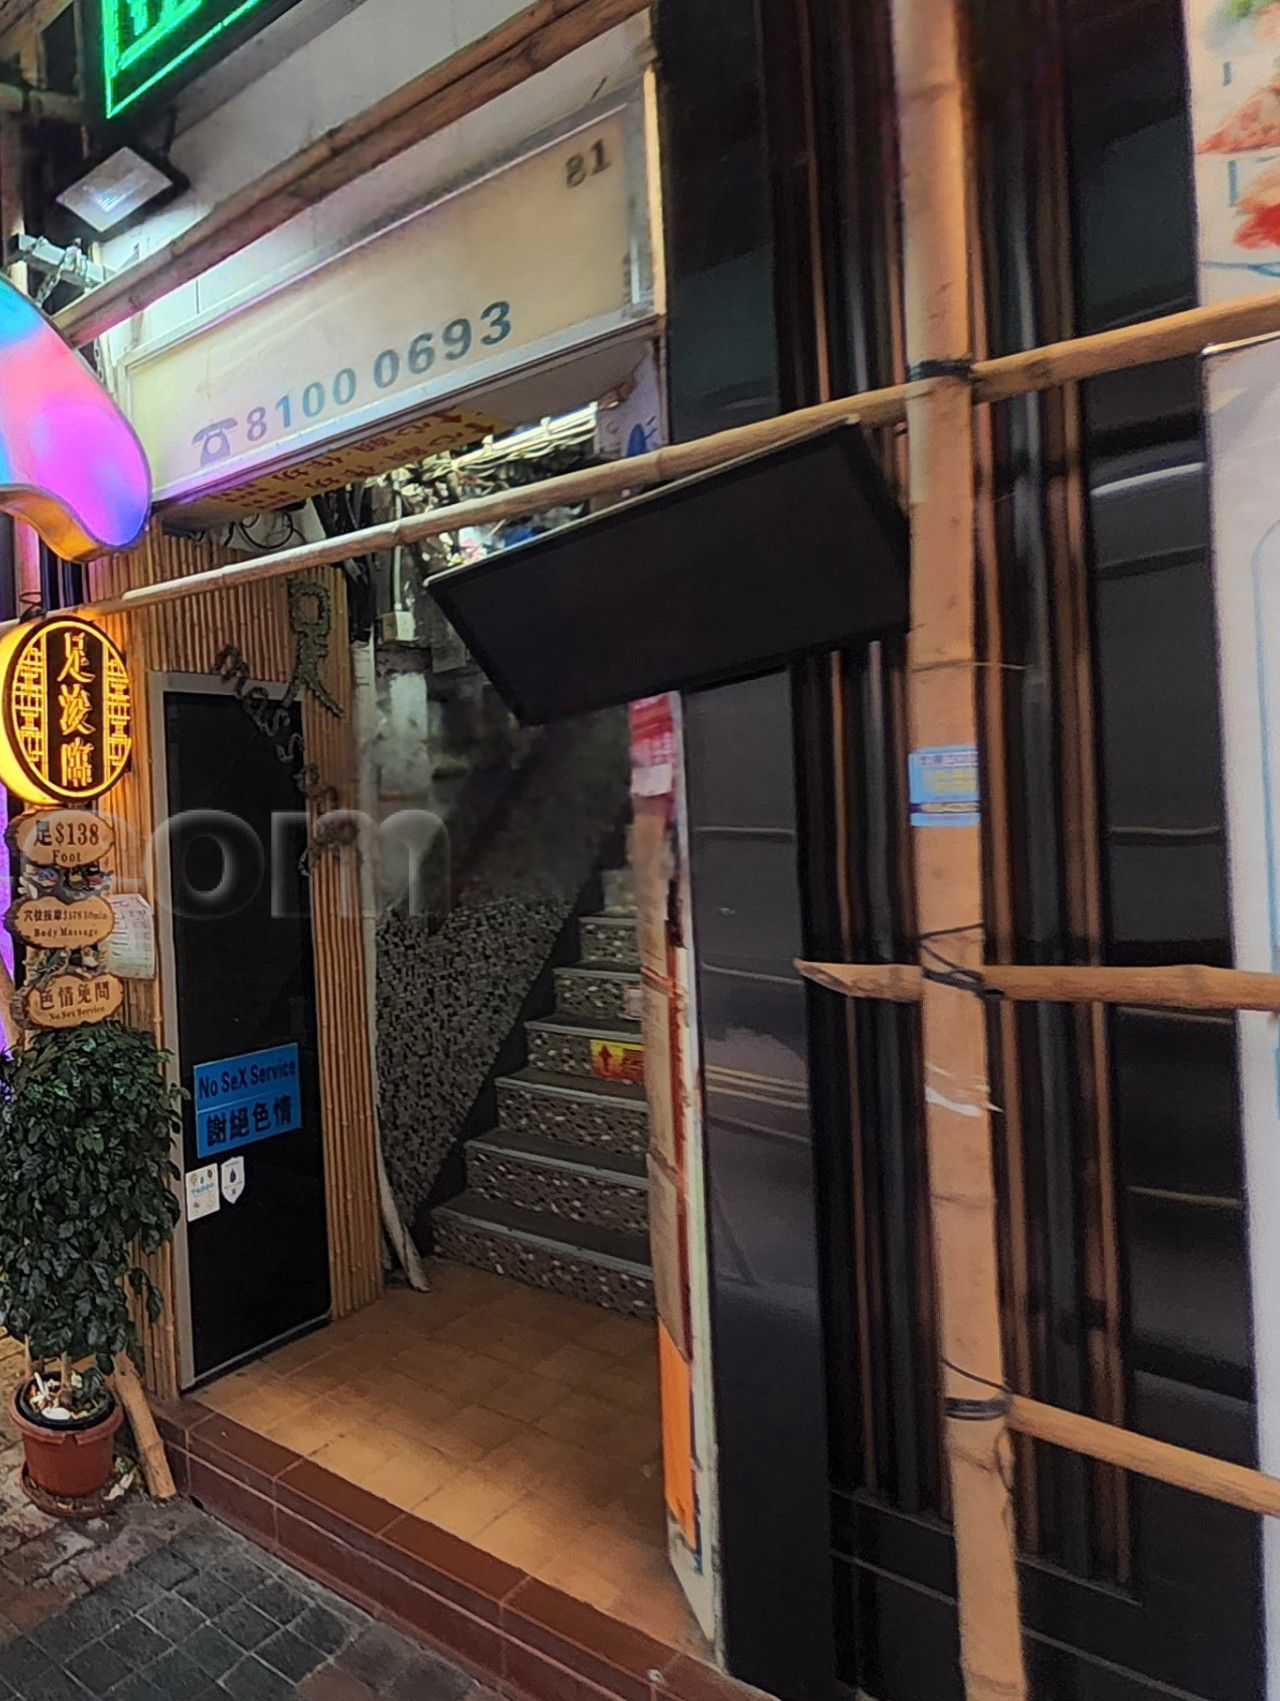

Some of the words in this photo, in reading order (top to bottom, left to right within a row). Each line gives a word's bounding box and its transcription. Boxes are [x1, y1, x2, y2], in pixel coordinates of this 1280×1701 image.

[565, 138, 611, 189] 81
[246, 367, 357, 442] 8100
[373, 300, 512, 389] 0693
[52, 849, 81, 863] Foot
[34, 928, 57, 938] Body
[61, 927, 98, 937] Massage
[200, 1075, 218, 1098] No
[250, 1060, 295, 1086] Service
